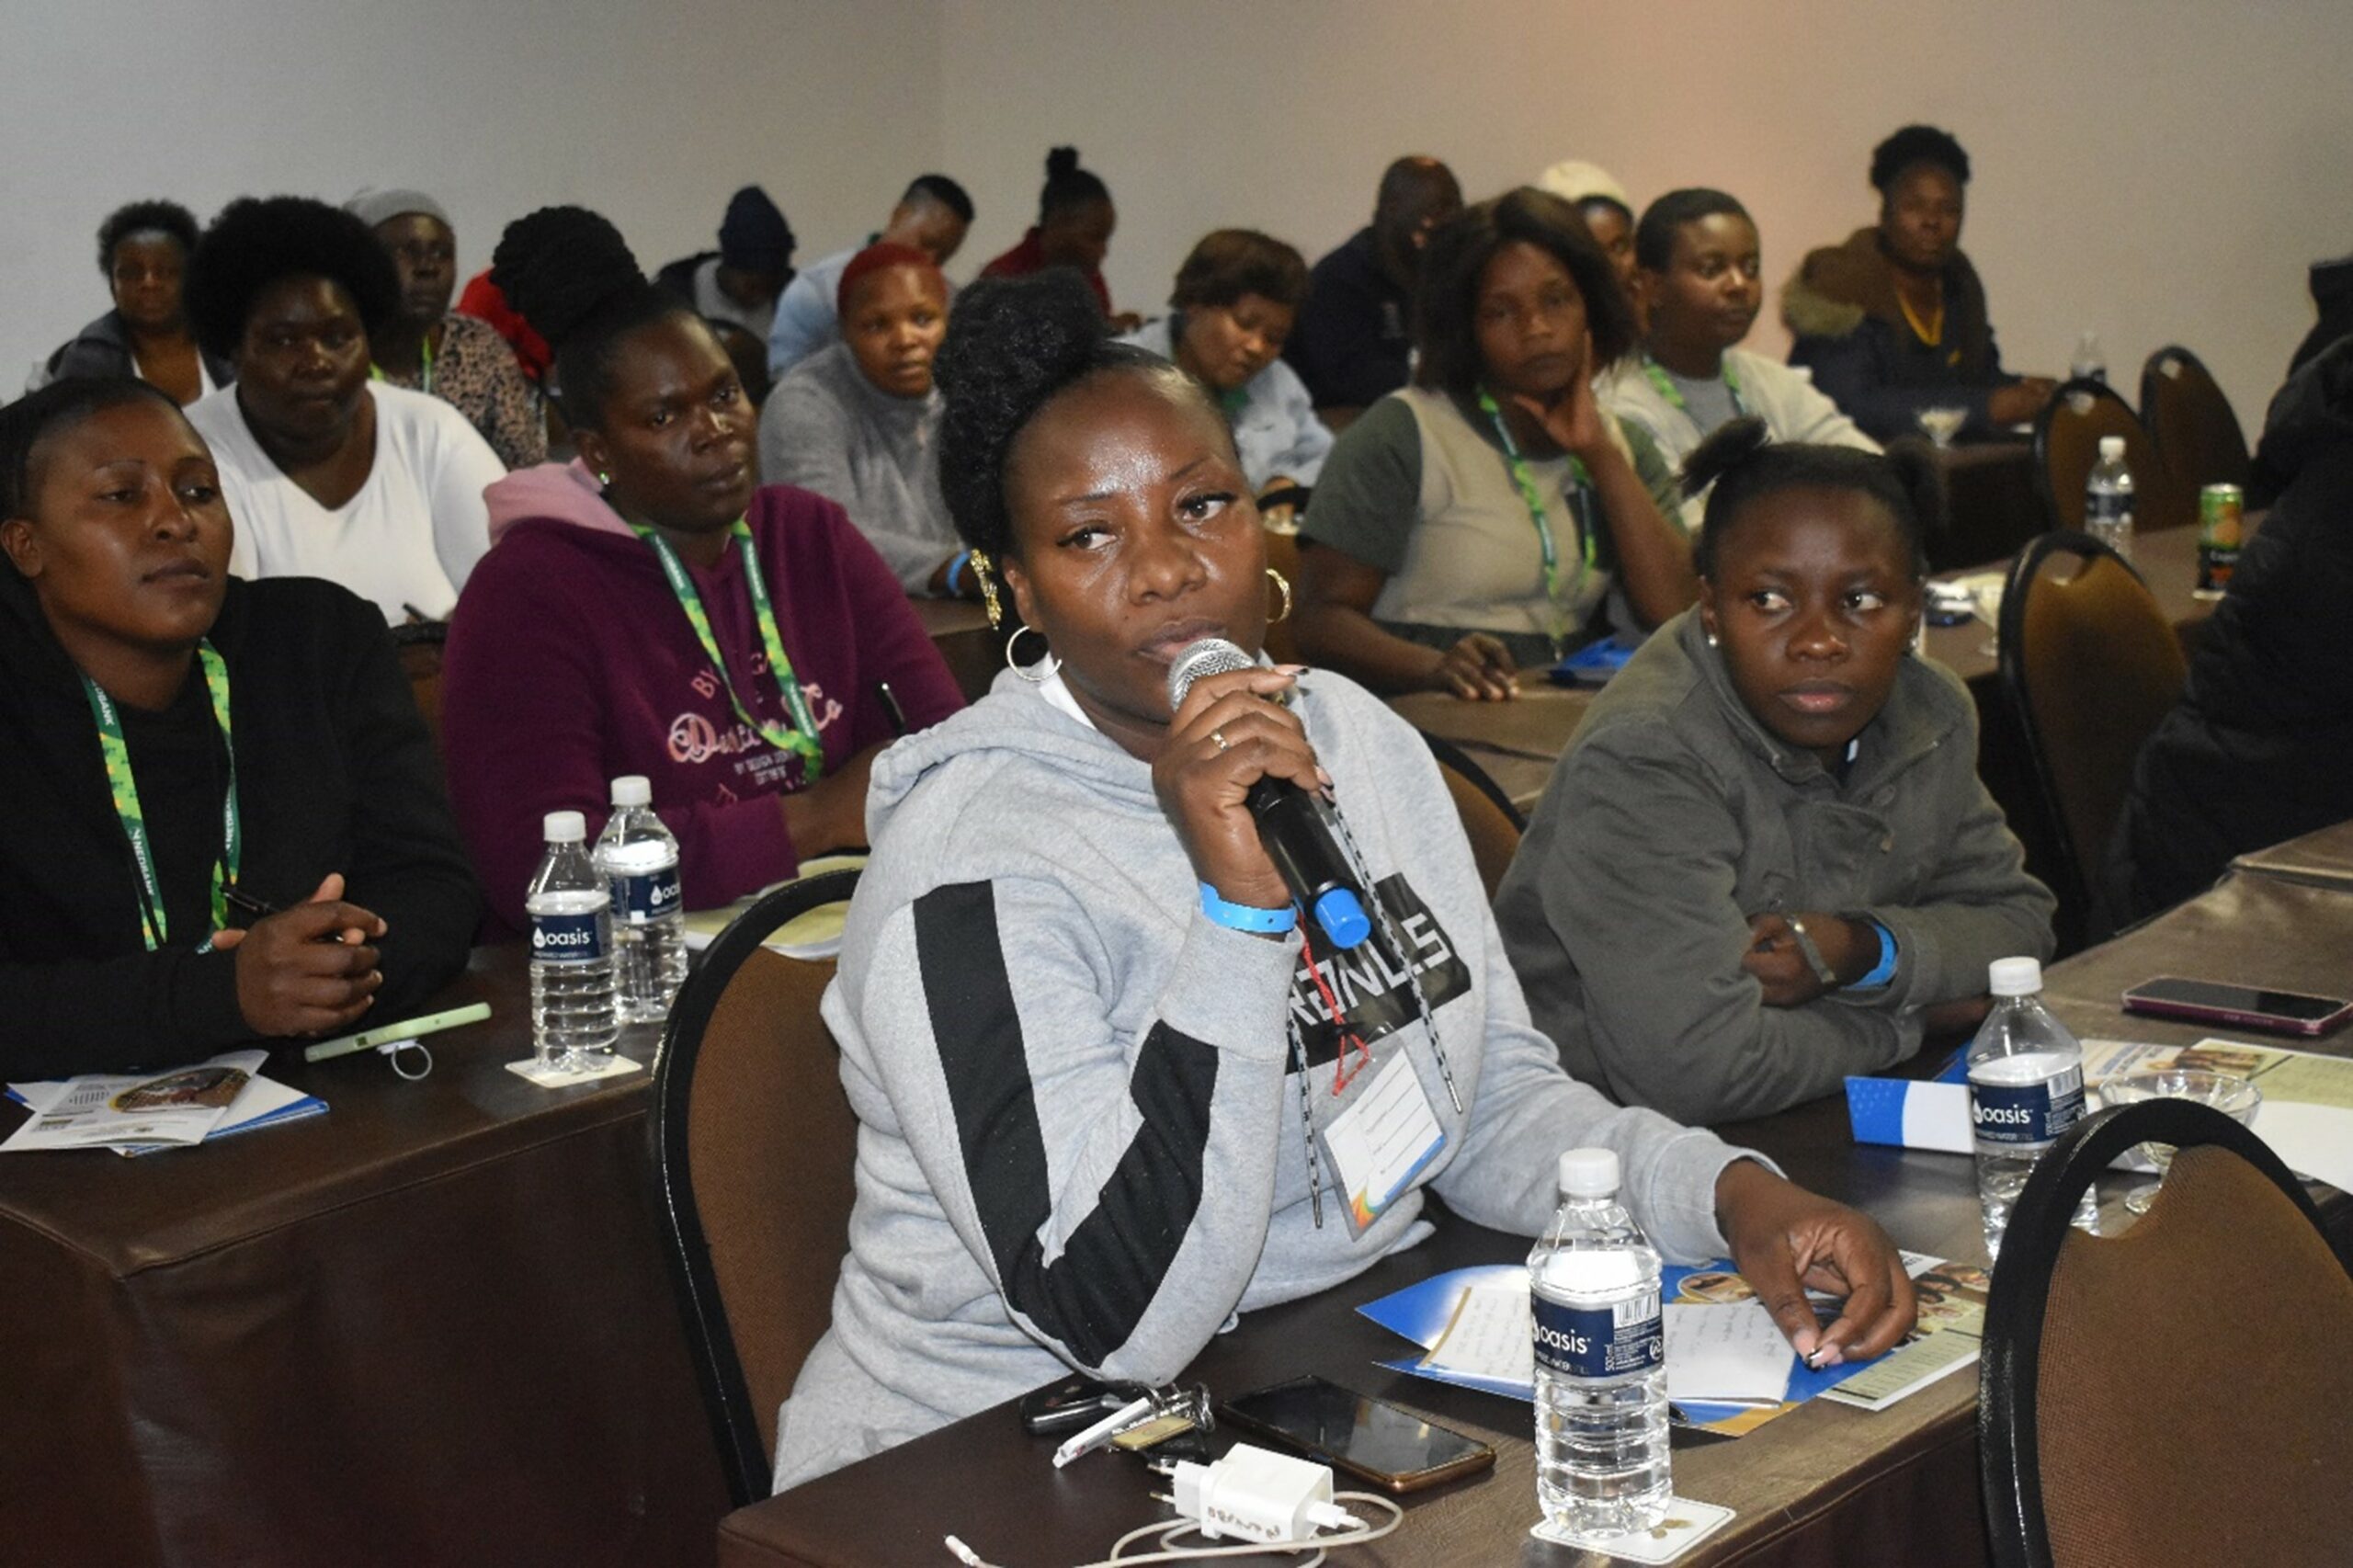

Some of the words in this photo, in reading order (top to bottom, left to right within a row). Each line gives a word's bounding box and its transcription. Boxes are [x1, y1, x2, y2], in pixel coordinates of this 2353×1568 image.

[93, 680, 115, 726] DBANK
[546, 927, 590, 946] oasis
[1984, 1104, 2030, 1124] oasis
[1540, 1324, 1588, 1355] oasis
